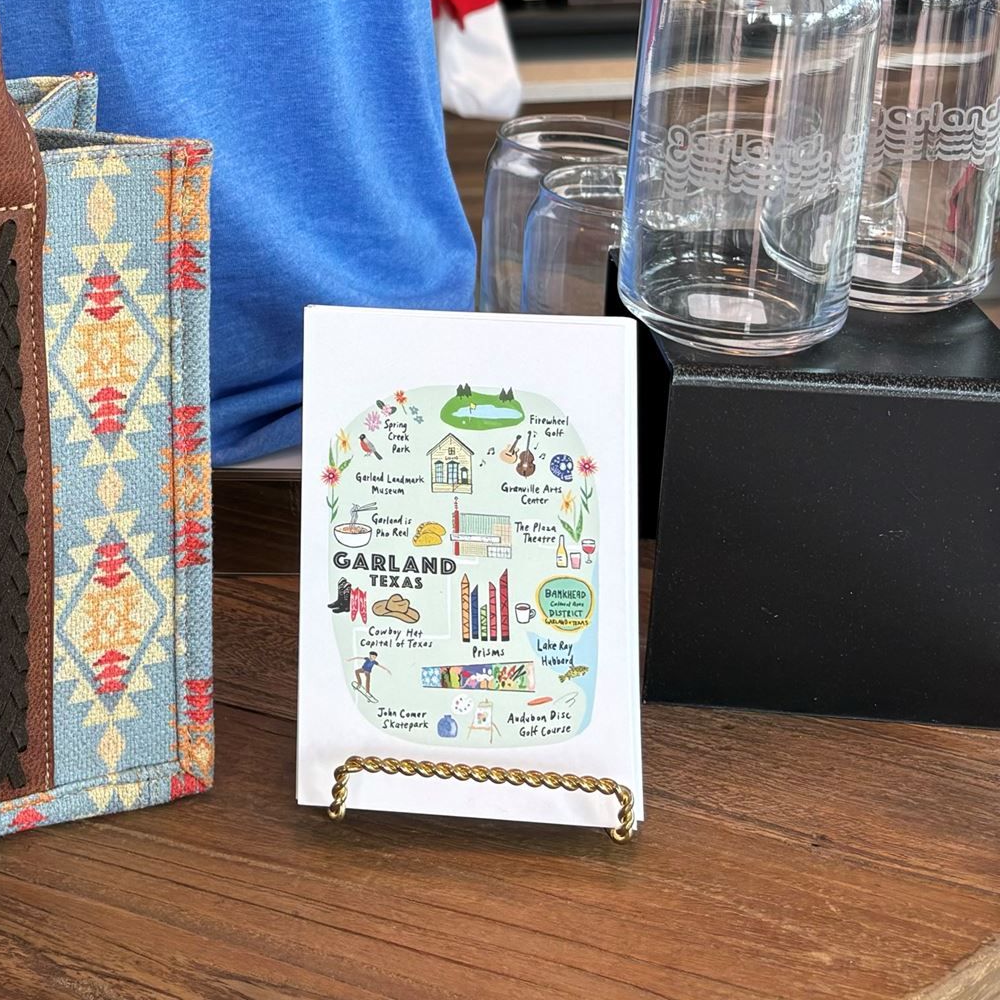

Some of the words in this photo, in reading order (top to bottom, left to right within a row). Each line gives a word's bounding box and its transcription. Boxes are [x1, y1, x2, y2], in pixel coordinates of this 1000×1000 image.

[384, 419, 407, 433] Spring
[529, 414, 569, 426] Firewheel
[388, 432, 409, 441] Creek
[545, 427, 565, 437] Golf
[392, 444, 410, 453] Park
[355, 472, 384, 483] Garland
[387, 472, 424, 484] Landmark
[372, 485, 404, 495] Museum
[501, 482, 540, 494] Granville
[543, 484, 562, 494] Arts
[521, 495, 549, 505] Center
[371, 513, 403, 525] Garland
[405, 517, 412, 525] is
[376, 528, 389, 537] Pho
[392, 528, 409, 537] Real
[514, 522, 530, 532] The
[533, 522, 557, 533] Plaza
[523, 533, 556, 544] Theatre
[333, 551, 456, 575] GARLAND
[369, 574, 423, 589] TEXAS
[545, 589, 586, 600] BANKHEAD
[549, 609, 583, 618] DISTRICT
[368, 626, 401, 640] Cowboy
[406, 628, 423, 638] Hat
[360, 639, 392, 649] Capital
[396, 639, 405, 648] of
[407, 639, 432, 648] Texas
[537, 638, 557, 651] Lake
[559, 641, 573, 655] Ray
[472, 646, 505, 658] Prisms
[541, 655, 574, 666] Hubbard
[377, 707, 396, 718] John
[399, 709, 427, 719] Comer
[507, 712, 547, 724] Audubon
[550, 711, 572, 721] Disc
[382, 719, 429, 732] Skatepark
[519, 726, 539, 737] Golf
[541, 725, 571, 737] Course
